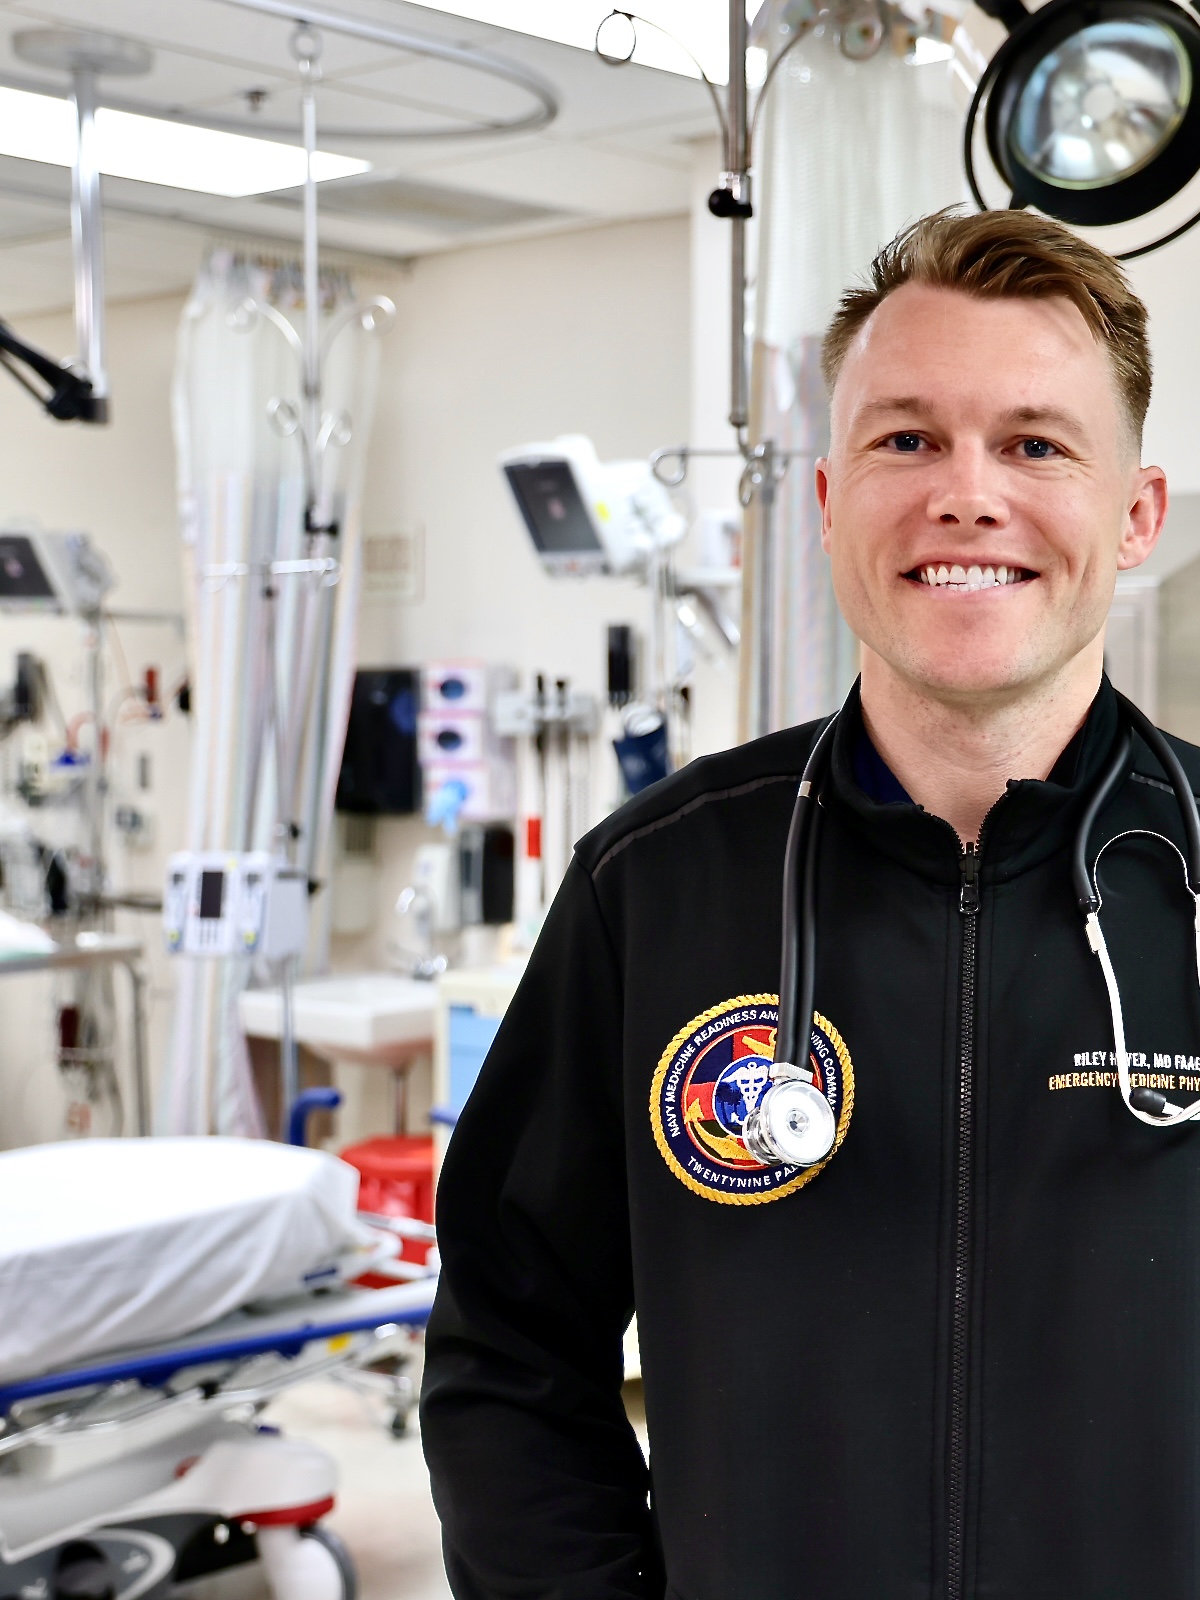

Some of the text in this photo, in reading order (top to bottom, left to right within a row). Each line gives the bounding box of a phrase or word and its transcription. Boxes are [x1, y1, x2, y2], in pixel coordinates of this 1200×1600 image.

[693, 1009, 757, 1047] READINESS
[758, 1010, 779, 1022] AN
[664, 1043, 696, 1103] MEDICINE
[1073, 1050, 1107, 1067] RILEY
[1109, 1051, 1151, 1069] HYER,
[1153, 1052, 1172, 1069] MD
[823, 1057, 837, 1111] COMMA
[1048, 1070, 1117, 1090] EMERGENCY
[666, 1105, 681, 1138] NAVY
[687, 1155, 799, 1188] TWENTYNINE PAL
